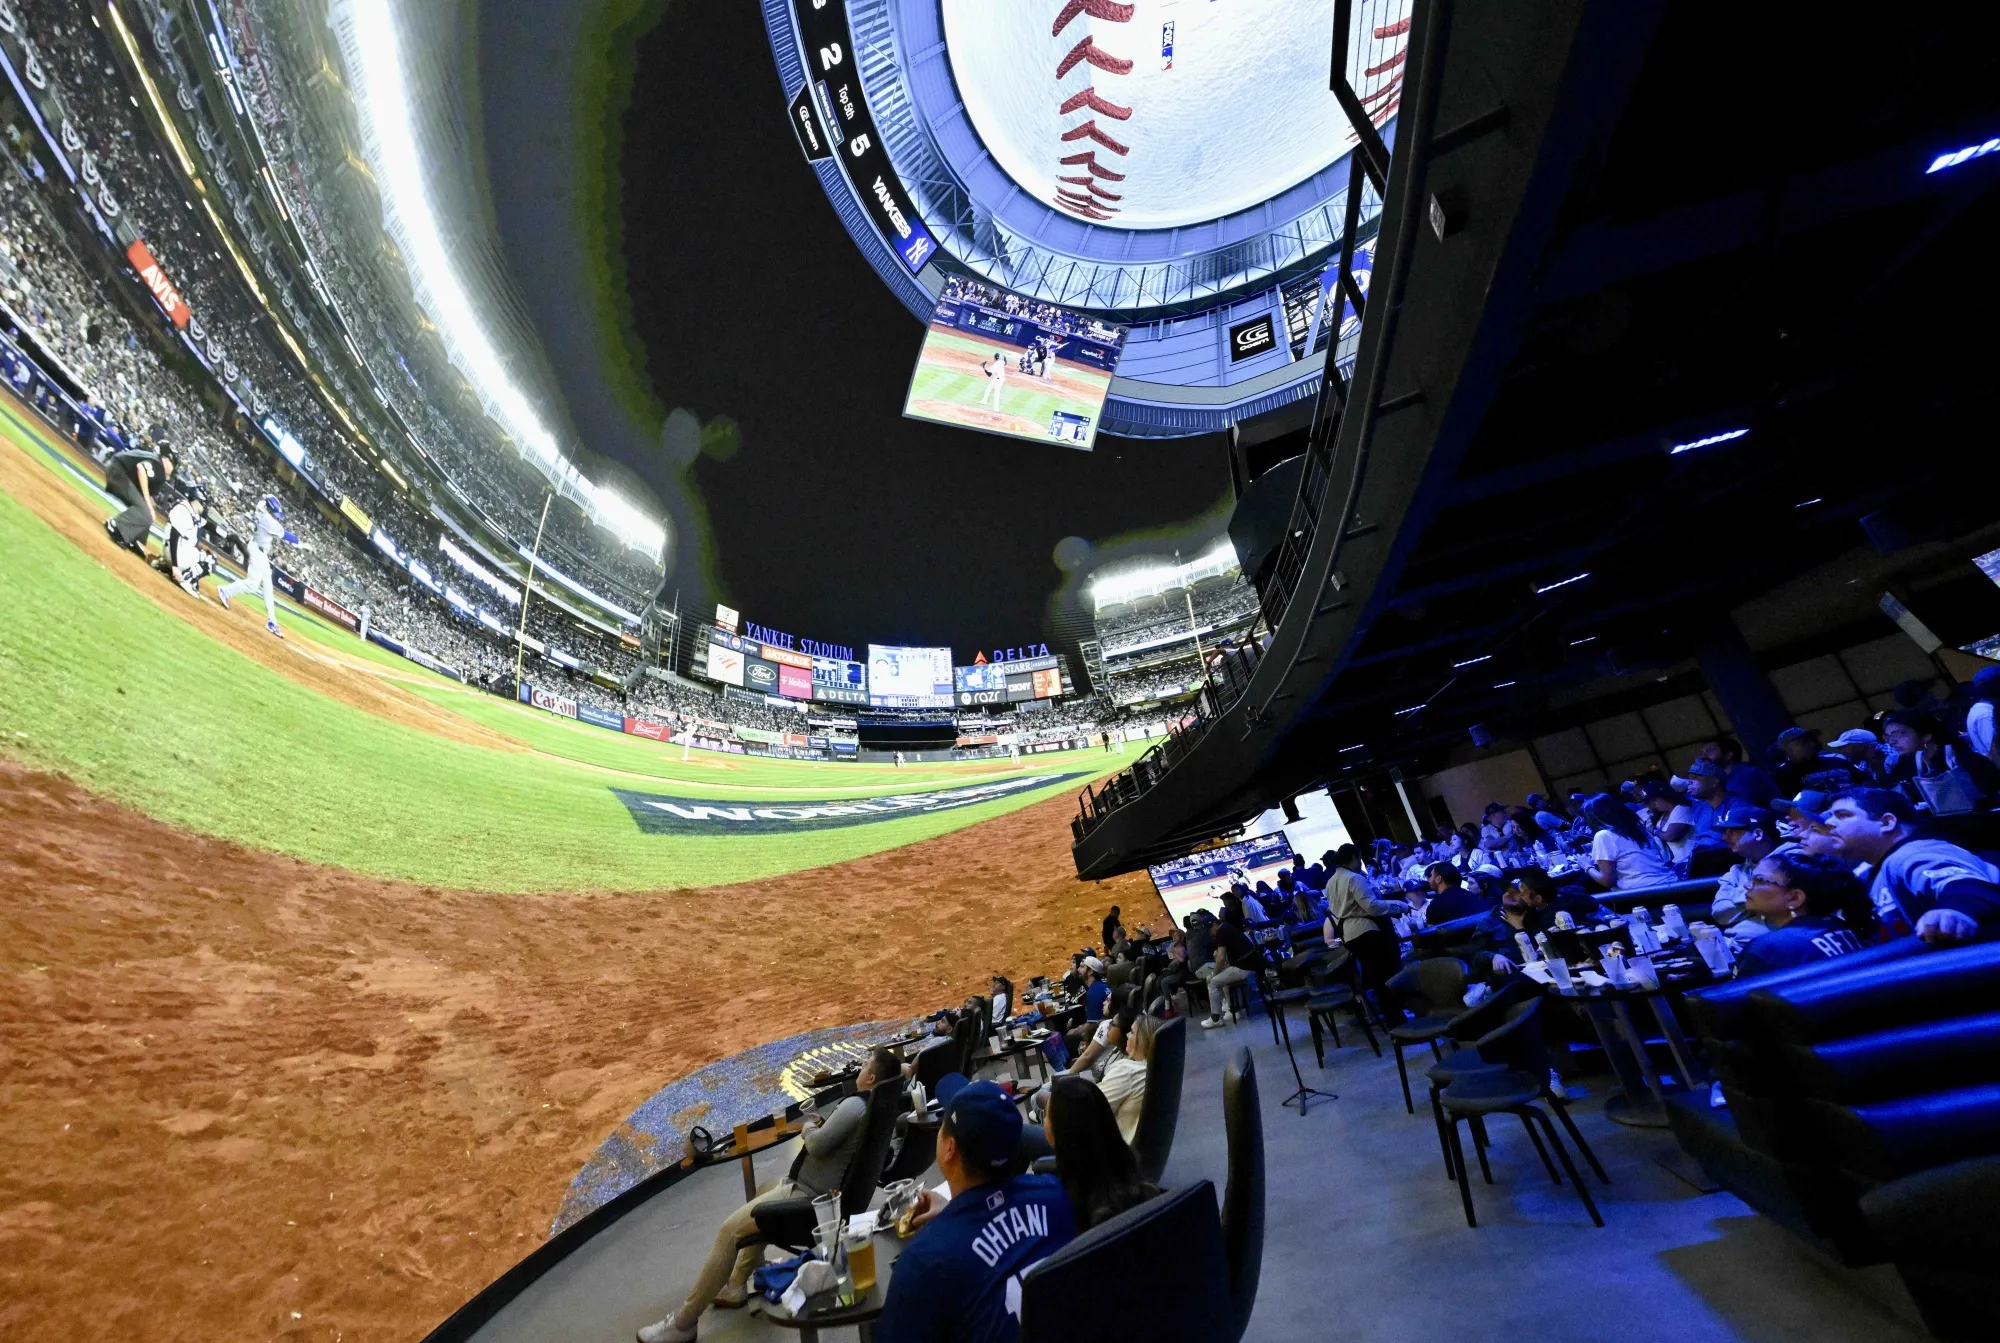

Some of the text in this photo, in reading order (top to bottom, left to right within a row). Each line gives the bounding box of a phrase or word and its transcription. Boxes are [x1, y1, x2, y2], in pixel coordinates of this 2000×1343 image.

[1163, 22, 1174, 47] FOX
[819, 43, 842, 71] 2
[839, 84, 856, 120] Top 5th
[850, 133, 871, 157] 5
[872, 175, 912, 240] YANKEES
[140, 264, 179, 312] AVIS
[745, 620, 853, 661] YANKEE STADIUM
[993, 643, 1050, 663] DELTA
[752, 666, 771, 680] Ford
[1004, 662, 1032, 674] STARR
[829, 690, 867, 702] DELTA
[974, 691, 1001, 704] razr
[1008, 682, 1032, 692] DKNY
[643, 798, 939, 821] WORLD
[971, 1203, 1049, 1268] OHTANI
